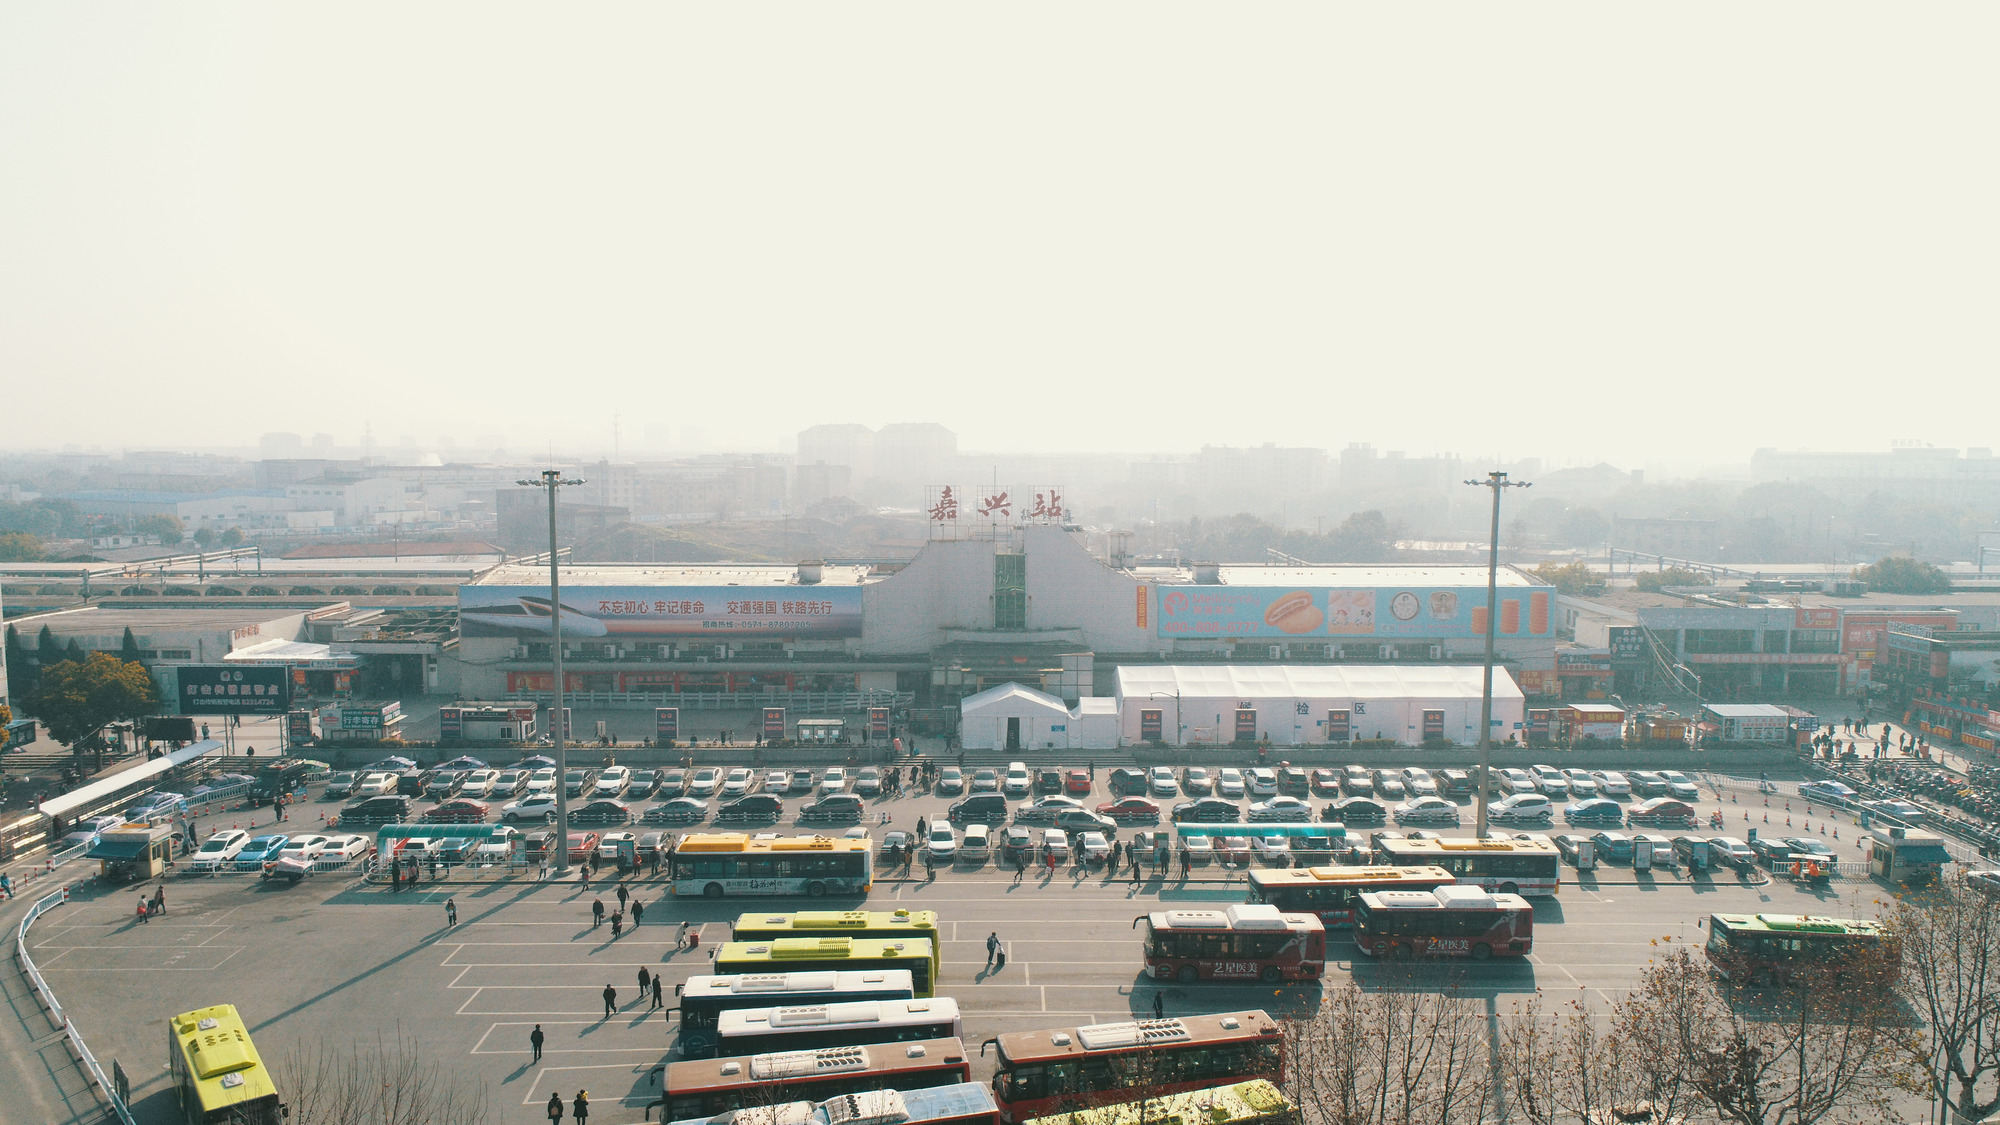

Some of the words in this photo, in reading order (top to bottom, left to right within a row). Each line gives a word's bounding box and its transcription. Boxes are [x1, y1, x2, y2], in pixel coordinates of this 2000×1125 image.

[928, 485, 1063, 521] 嘉兴站
[598, 600, 649, 615] 不忘初心
[654, 600, 705, 615] 牢记使命
[727, 600, 777, 615] 交通强国
[781, 600, 833, 615] 铁路先行
[1164, 622, 1259, 633] 400-808-6777
[343, 716, 379, 725] 行李寄存
[1214, 962, 1258, 973] 艺星医美
